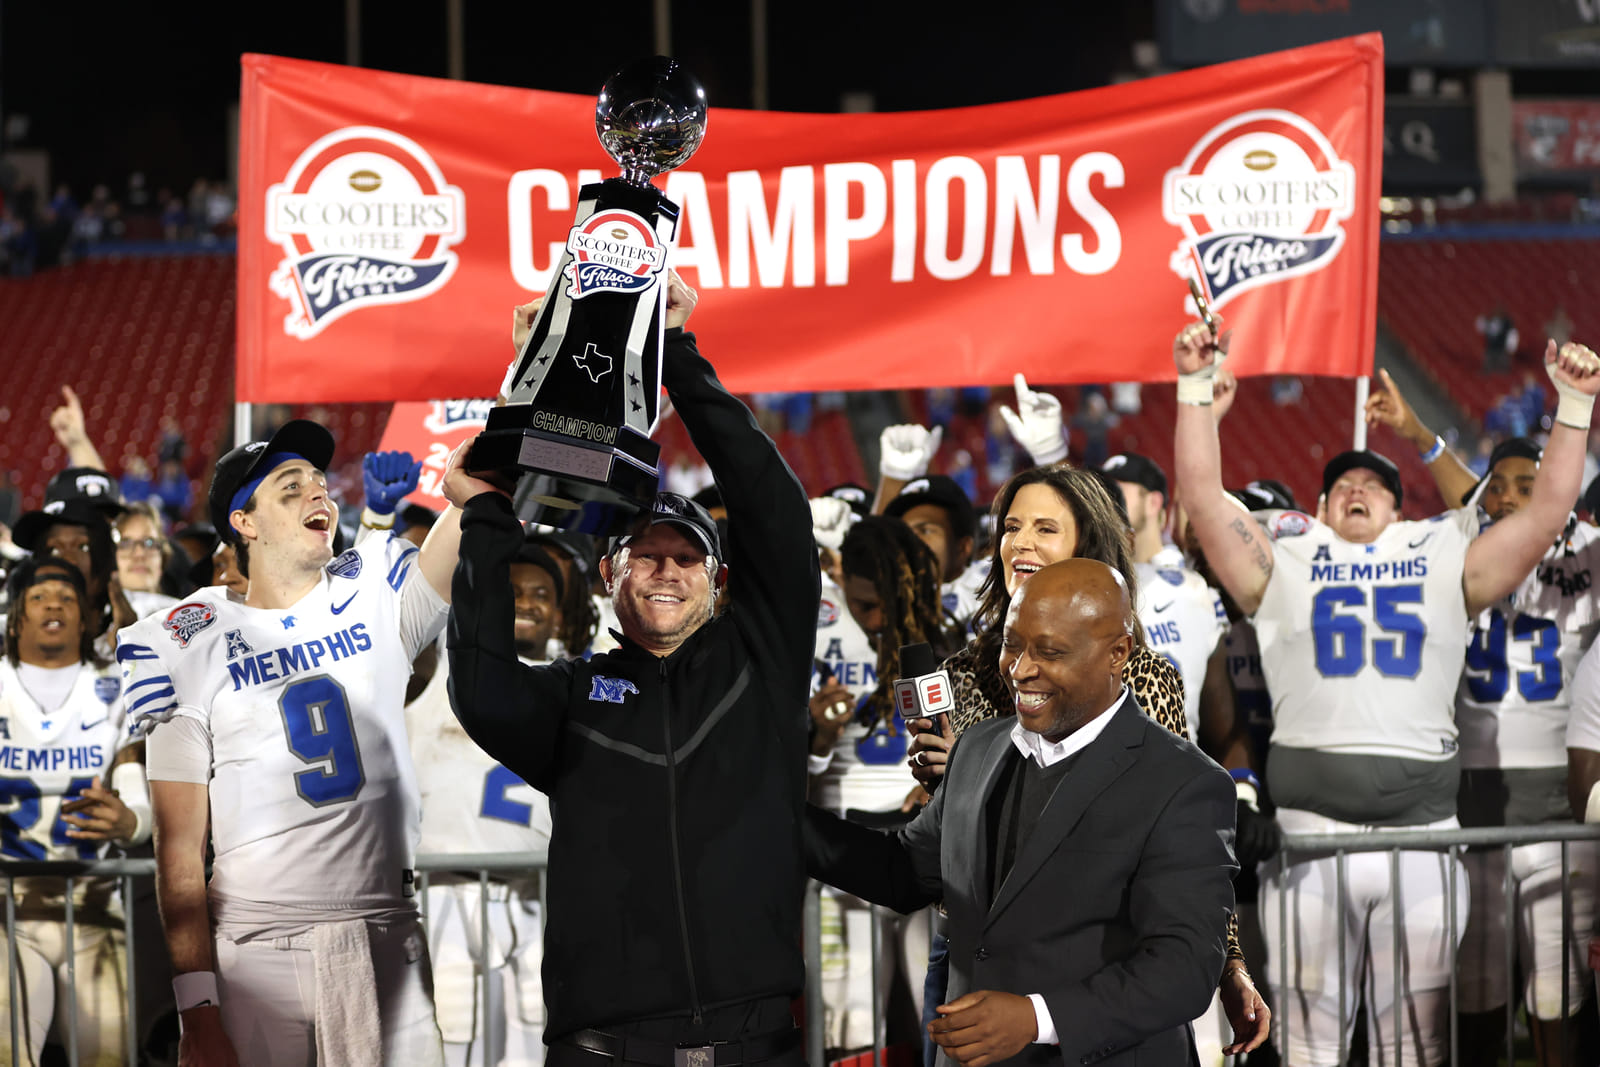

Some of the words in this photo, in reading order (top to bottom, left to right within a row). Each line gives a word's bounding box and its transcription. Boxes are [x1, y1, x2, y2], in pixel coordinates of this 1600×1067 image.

[1180, 178, 1339, 206] SCOOTER'S
[282, 202, 448, 228] SCOOTER'S
[1221, 210, 1294, 229] COFFEE
[323, 231, 404, 250] COFFEE
[575, 235, 657, 263] SCOOTER'S
[593, 253, 633, 269] COFFEE
[1202, 234, 1308, 287] Frisco
[303, 256, 418, 308] Frisco
[580, 265, 635, 287] Frisco
[532, 411, 618, 445] CHAMPION
[1310, 556, 1429, 582] MEMPHIS
[1310, 582, 1428, 681] 65
[227, 622, 372, 692] MEMPHIS
[1465, 608, 1563, 703] 93
[277, 673, 366, 809] 9
